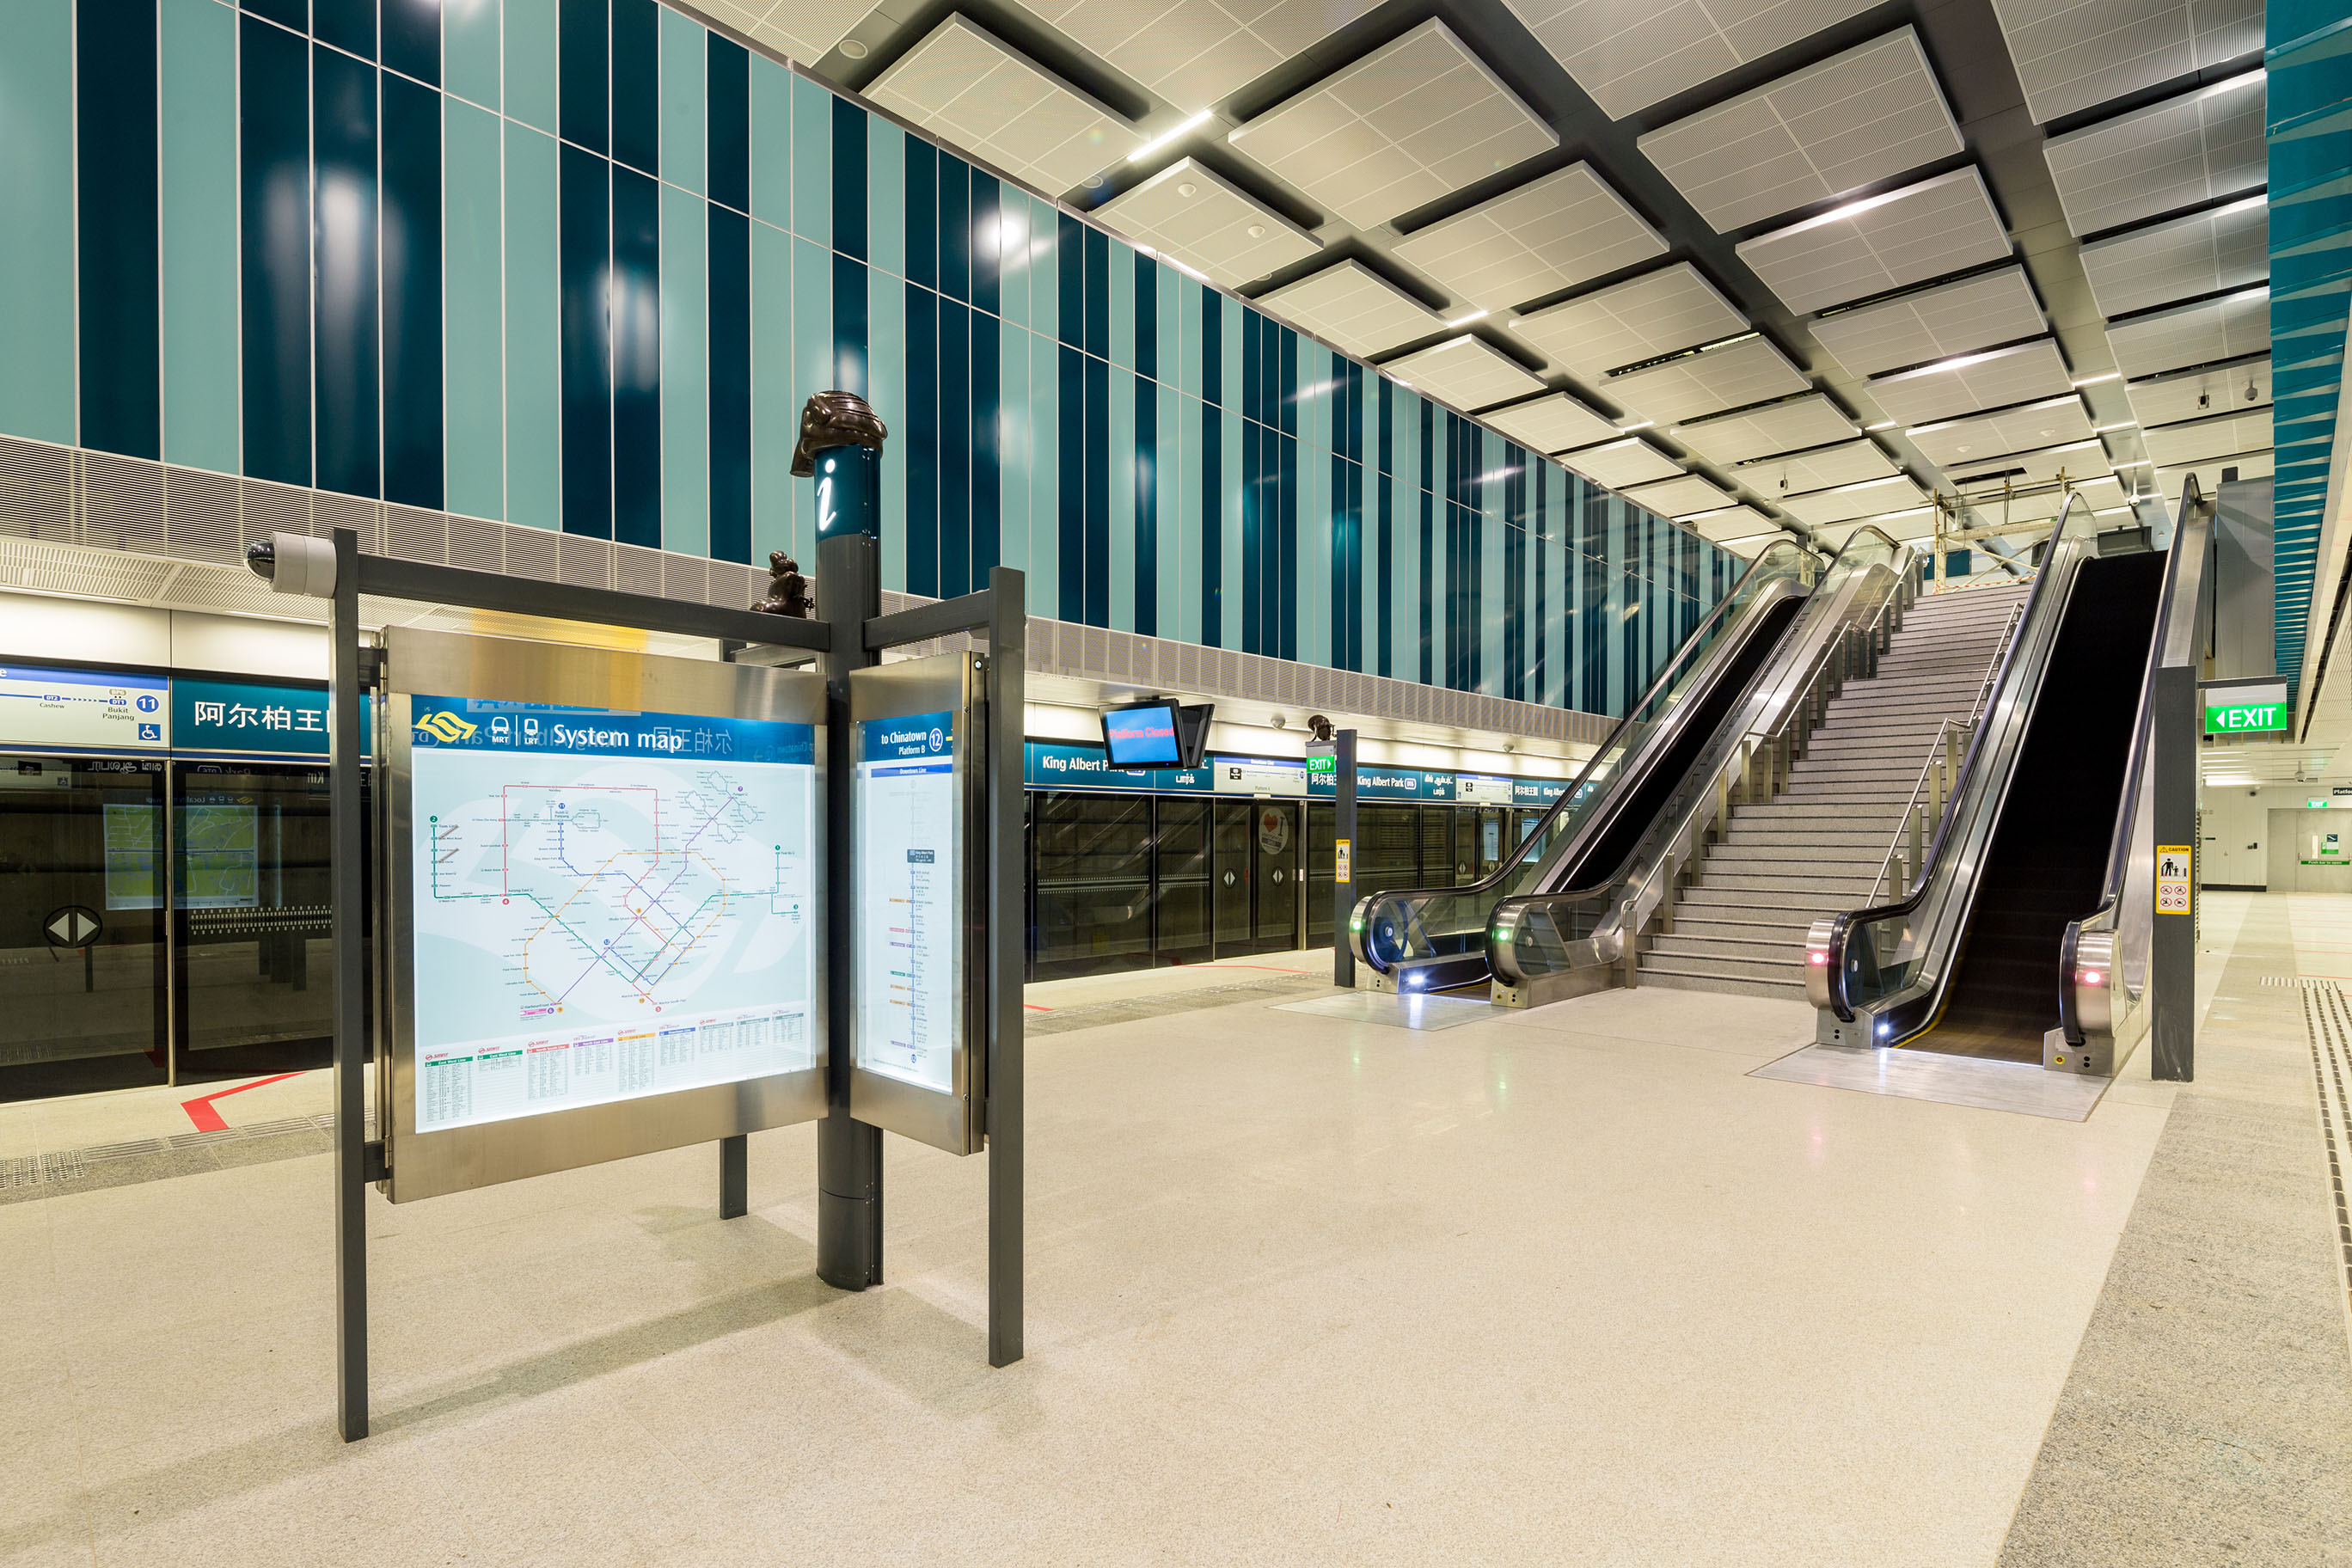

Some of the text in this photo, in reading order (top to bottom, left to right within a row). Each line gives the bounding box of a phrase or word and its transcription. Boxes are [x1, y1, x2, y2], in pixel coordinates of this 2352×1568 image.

[818, 458, 836, 531] i
[138, 697, 156, 710] 11
[102, 713, 135, 722] Panjang
[194, 701, 331, 733] 阿尔柏王
[2228, 707, 2277, 728] EXIT
[554, 724, 683, 754] System map
[881, 731, 940, 747] to Chinatown 12
[1108, 726, 1175, 740] Platform Closed
[898, 744, 926, 756] Platform B
[1042, 756, 1067, 772] King
[1069, 756, 1100, 771] Albert
[1309, 758, 1327, 771] EXIT
[1175, 773, 1195, 785] பார்க்
[1357, 775, 1371, 787] King
[1372, 776, 1390, 787] Albert
[1391, 777, 1405, 787] Park
